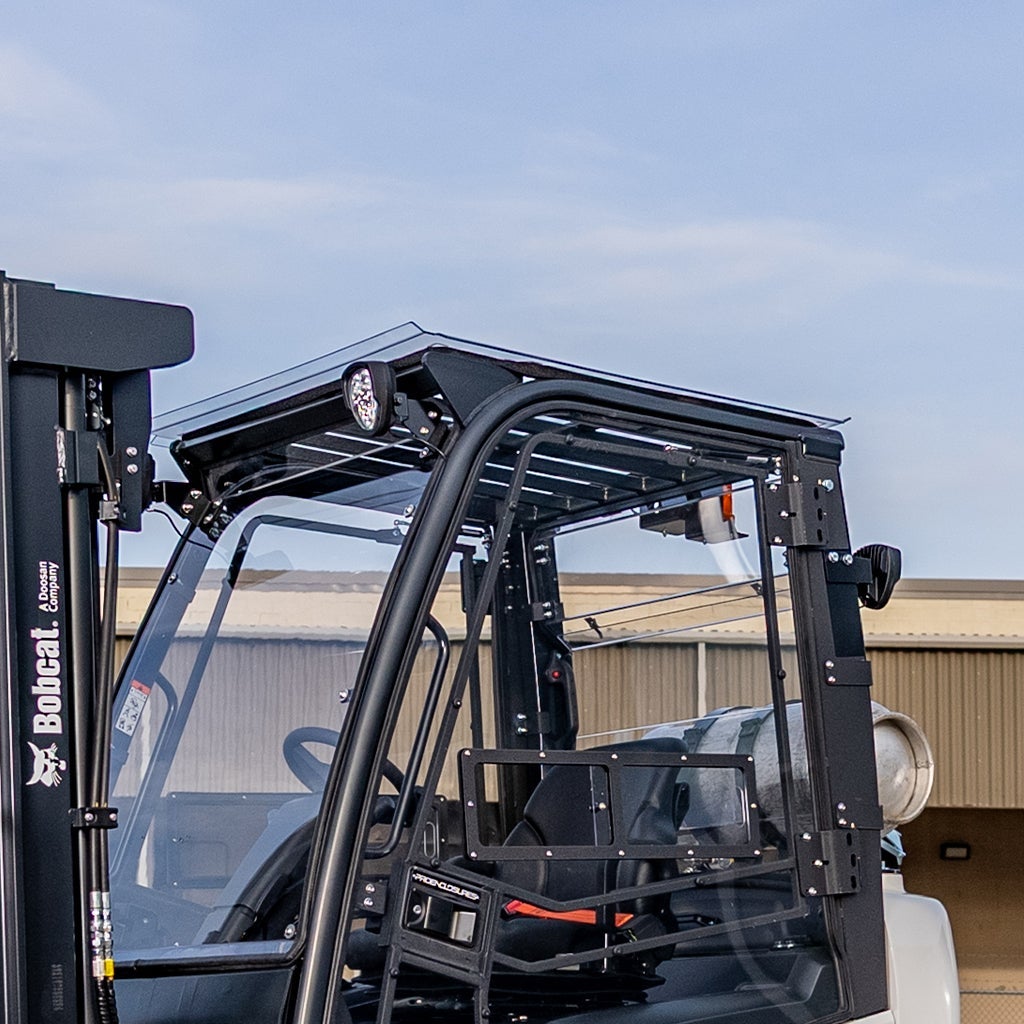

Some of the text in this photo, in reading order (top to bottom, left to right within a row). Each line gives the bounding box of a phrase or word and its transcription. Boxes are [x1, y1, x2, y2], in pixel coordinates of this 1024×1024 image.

[38, 560, 49, 612] A Doosan
[48, 561, 61, 613] Company
[414, 873, 479, 901] PROENCLOSURES
